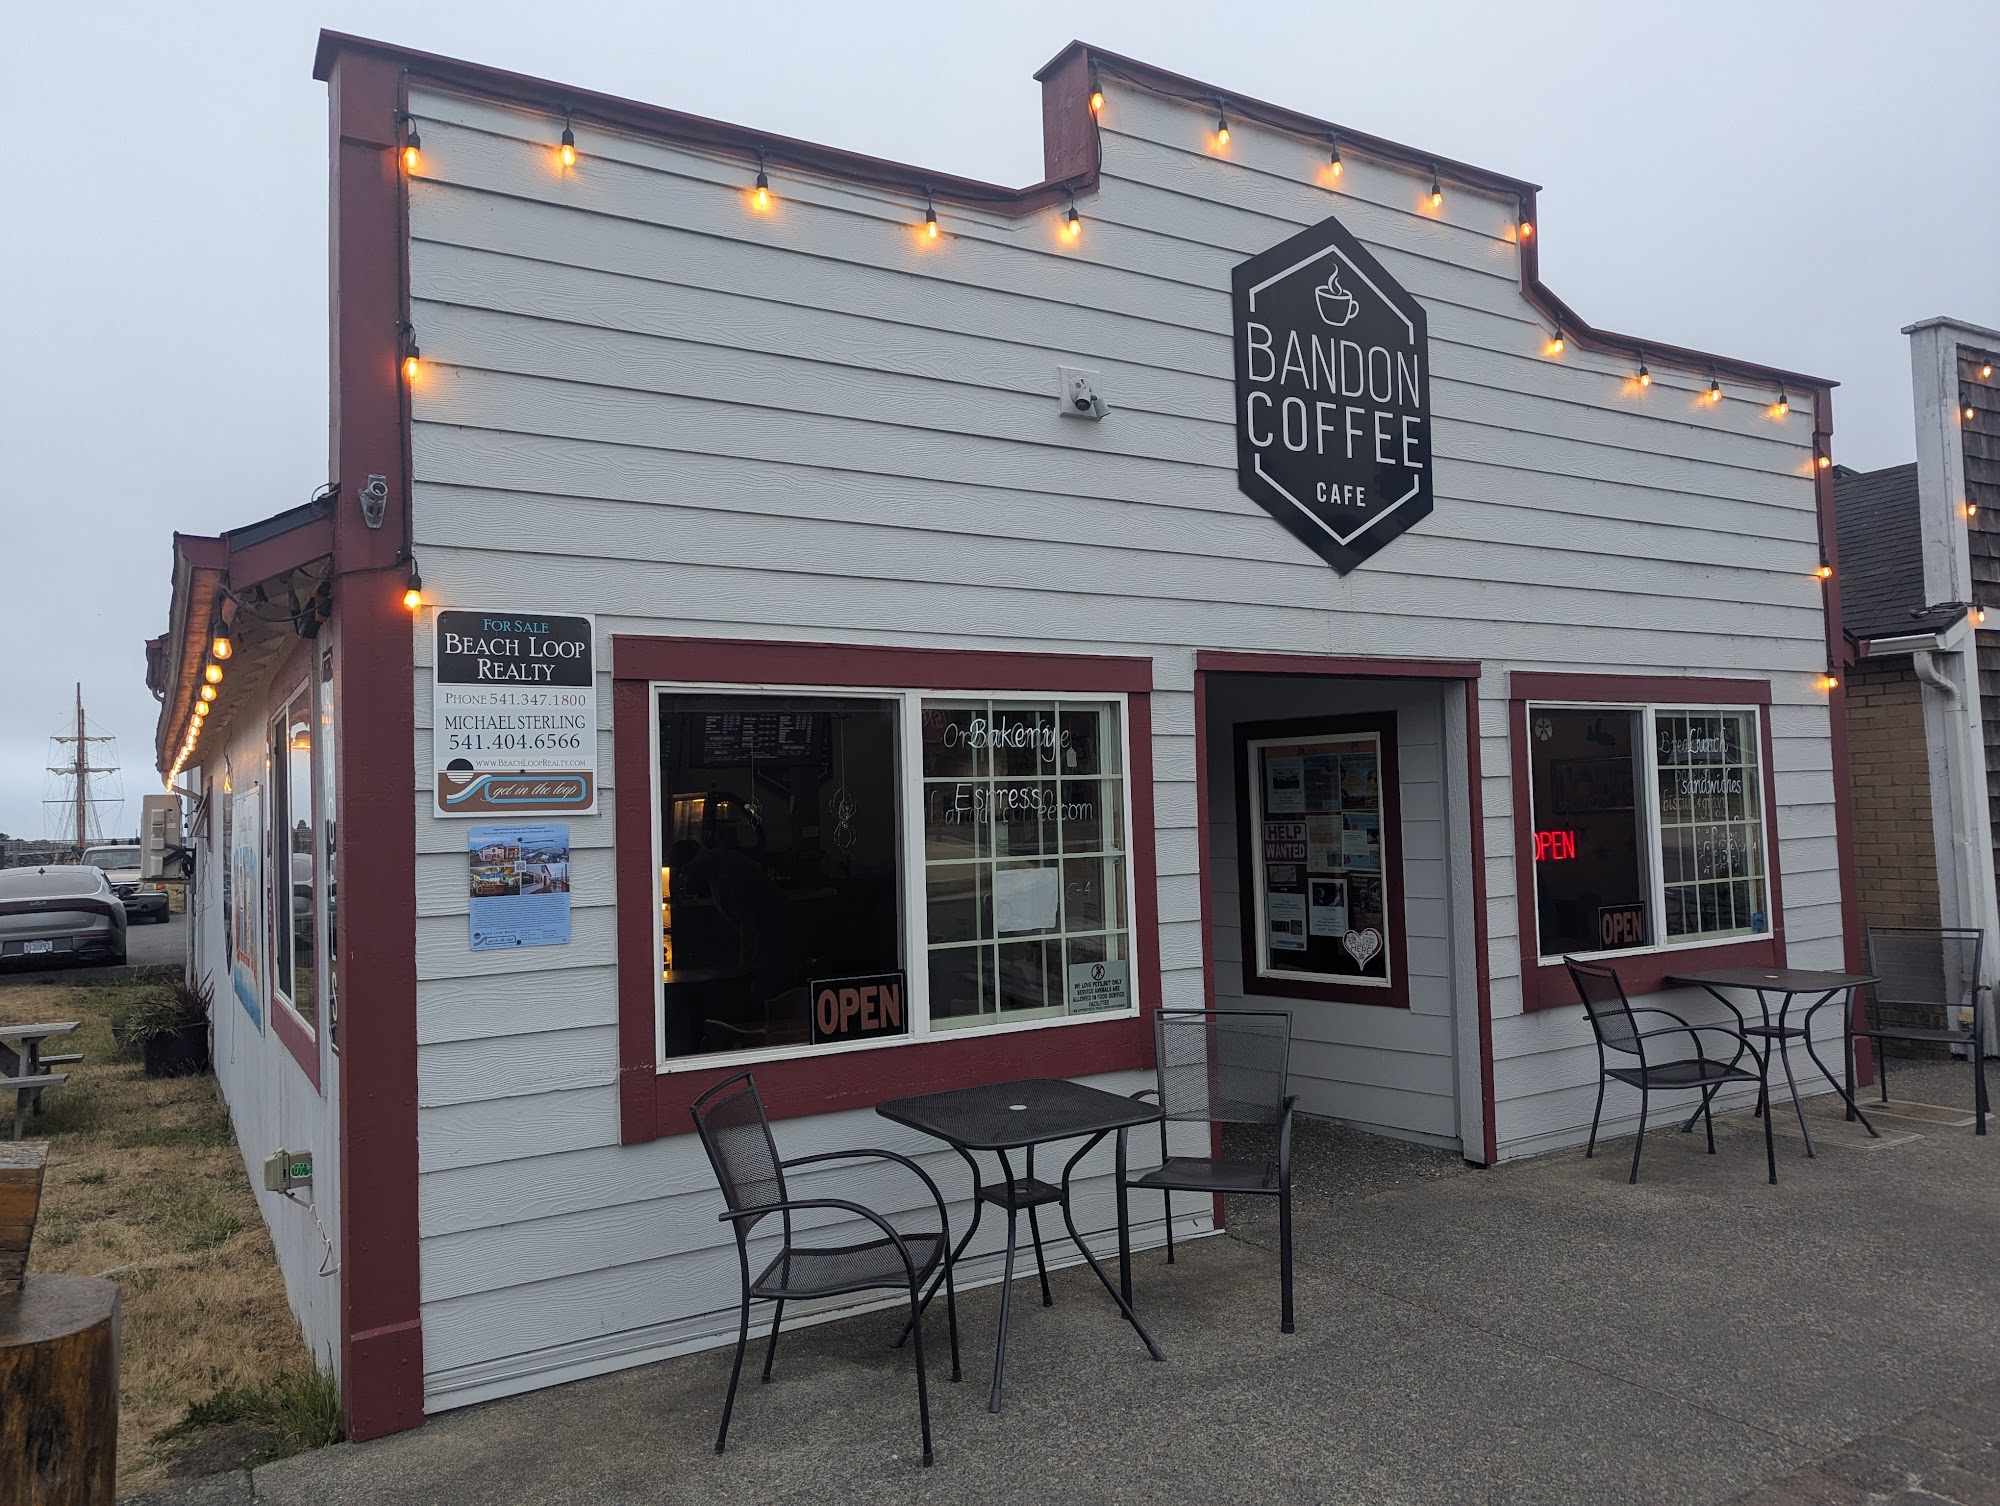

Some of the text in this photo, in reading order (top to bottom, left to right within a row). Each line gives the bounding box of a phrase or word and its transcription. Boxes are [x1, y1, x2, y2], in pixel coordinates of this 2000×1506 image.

[1247, 321, 1420, 408] BANDON
[1247, 391, 1424, 469] COFFEE
[1316, 481, 1366, 507] CAFE
[483, 618, 550, 634] FOR SALE
[444, 632, 586, 659] BEACH LOOP
[477, 658, 556, 681] REALTY
[445, 692, 586, 706] PHONE 541.347.1800
[444, 714, 586, 730] MICHAEL STERLING
[449, 732, 580, 750] 541.404.6566
[968, 715, 1057, 762] Bakery
[490, 781, 578, 801] get in the loop
[1267, 825, 1301, 840] HELP
[1265, 842, 1305, 859] WANTED
[1601, 910, 1643, 945] OPEN
[816, 983, 901, 1035] OPEN
